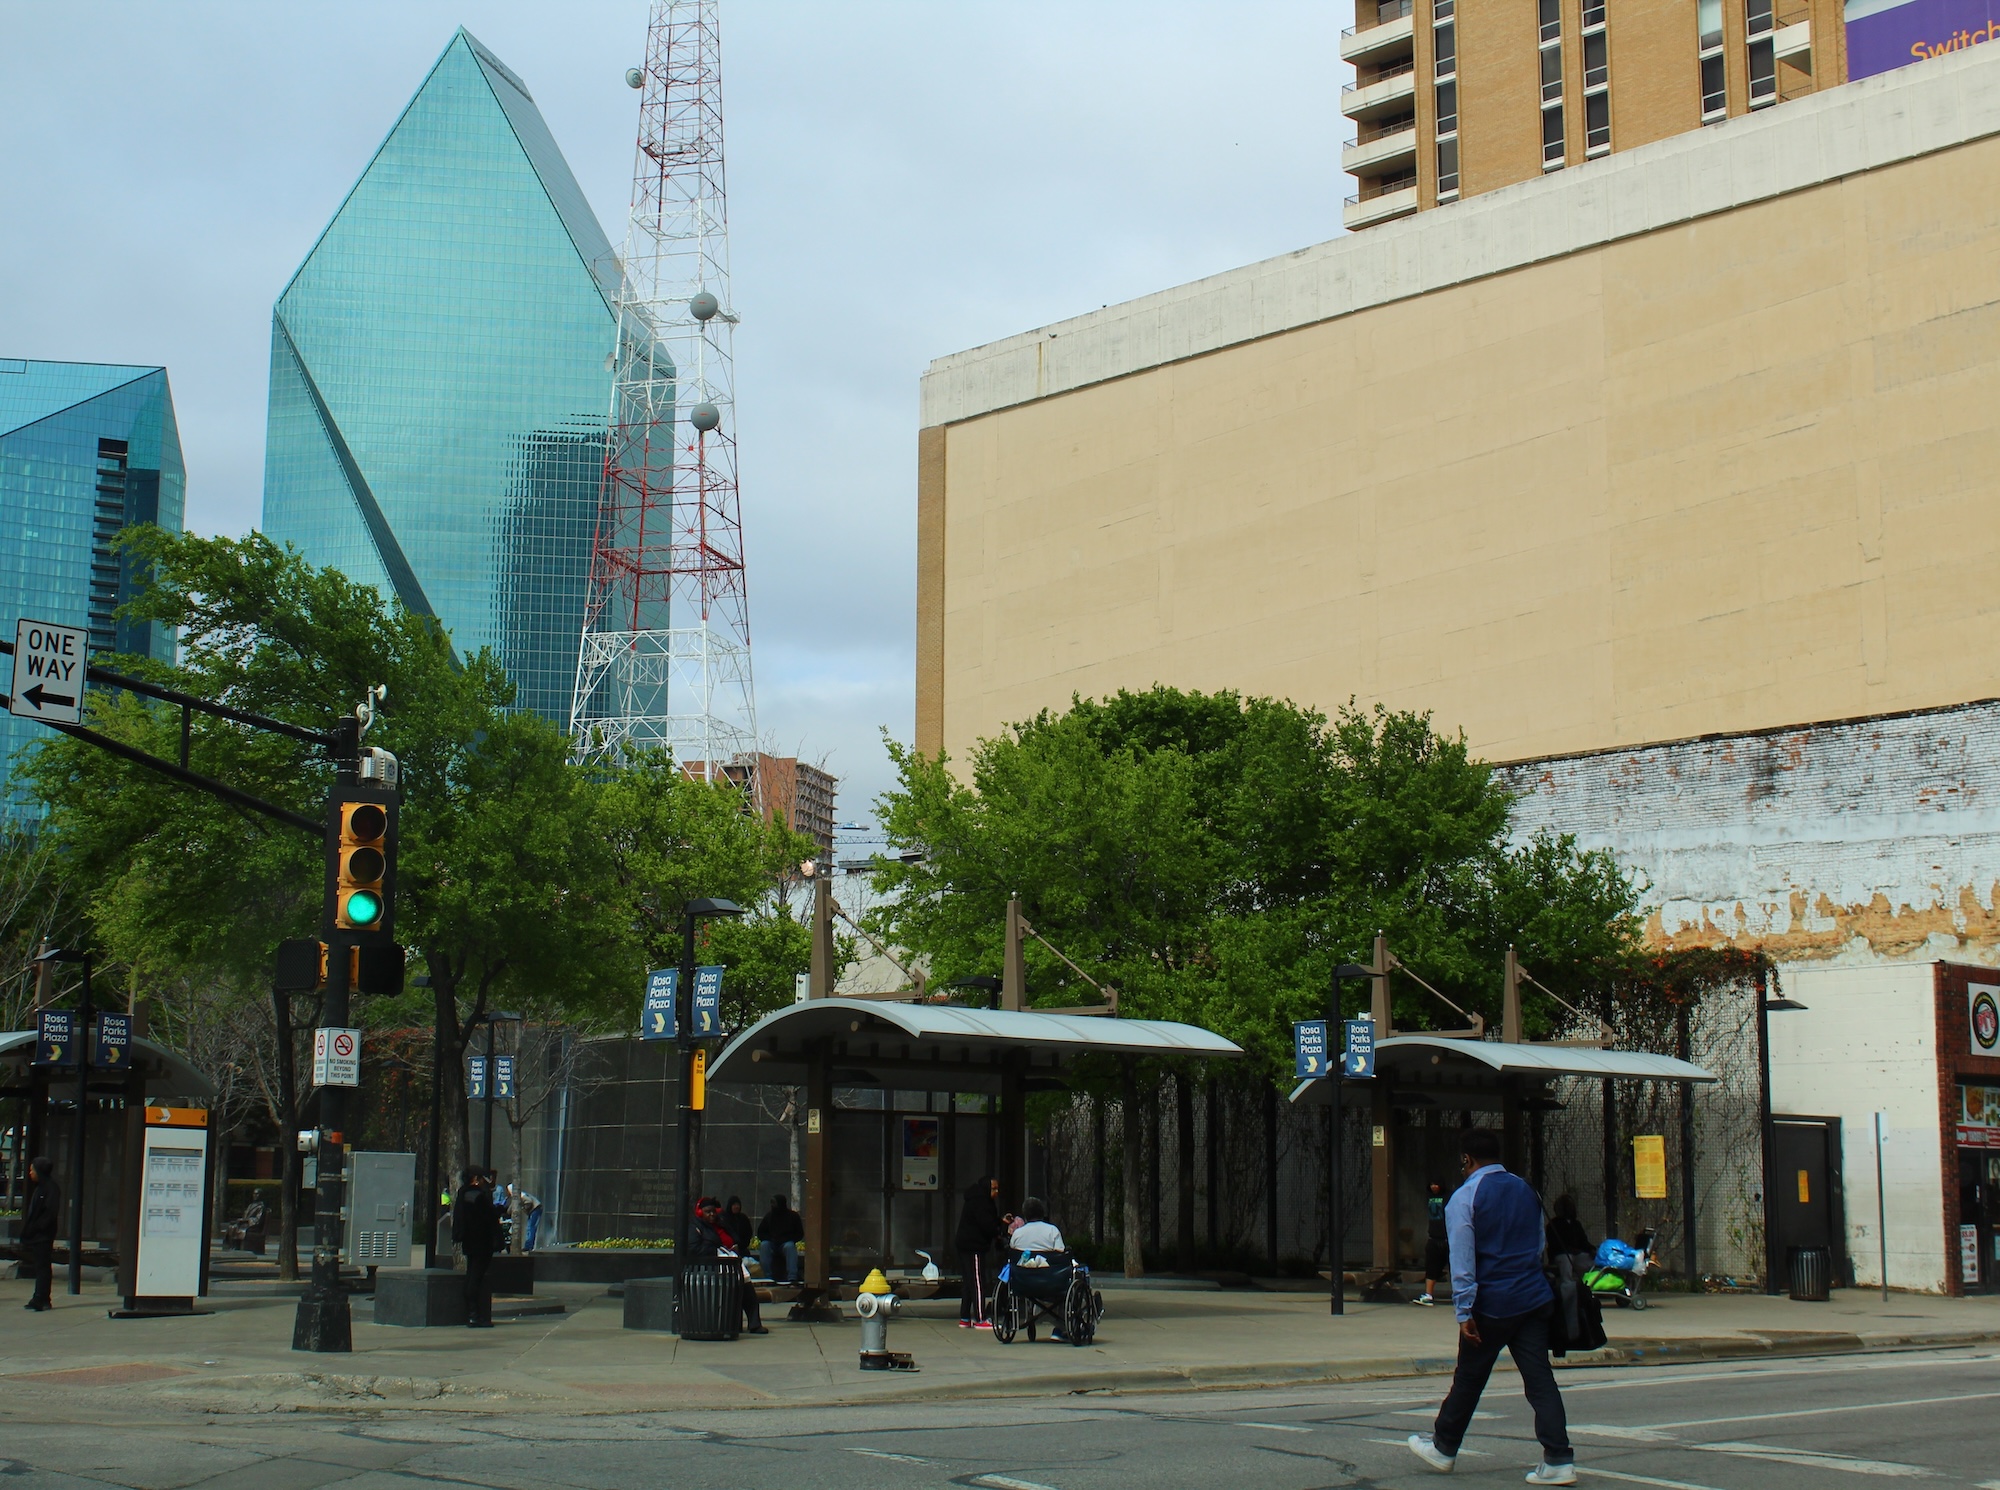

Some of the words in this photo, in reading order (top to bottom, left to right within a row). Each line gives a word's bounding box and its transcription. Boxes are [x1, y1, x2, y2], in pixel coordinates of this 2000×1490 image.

[29, 629, 75, 656] ONE
[28, 654, 76, 681] WAY
[652, 976, 672, 986] Rosa
[700, 972, 718, 983] Rosa
[650, 986, 671, 998] Parks
[697, 983, 716, 995] Parks
[648, 998, 670, 1010] Plaza
[696, 996, 714, 1007] Plaza
[45, 1014, 67, 1023] Rosa
[104, 1016, 126, 1026] Rosa
[44, 1023, 68, 1033] Parks
[102, 1026, 127, 1036] Parks
[1300, 1026, 1320, 1034] Rosa
[1350, 1025, 1368, 1034] Rosa
[43, 1033, 68, 1042] Plaza
[102, 1035, 126, 1045] Plaza
[1300, 1035, 1322, 1044] Parks
[1350, 1034, 1370, 1043] Parks
[1300, 1044, 1322, 1054] Plaza
[1350, 1044, 1370, 1053] Plaza
[200, 1115, 205, 1123] 4
